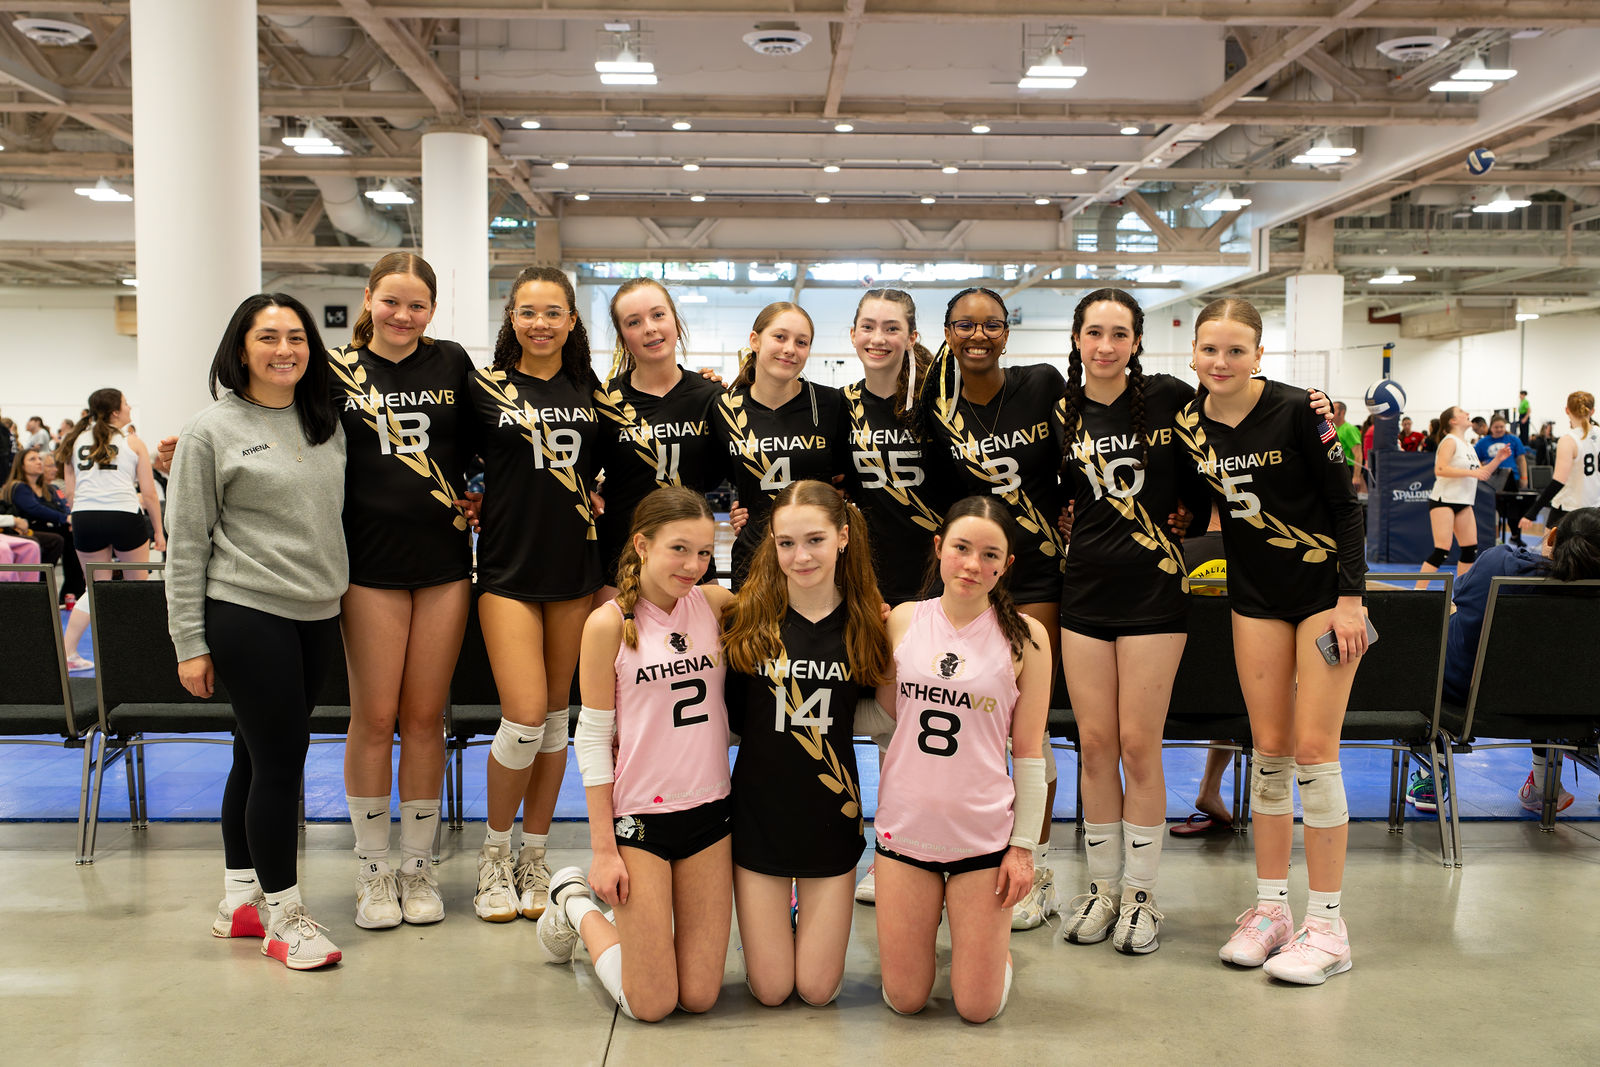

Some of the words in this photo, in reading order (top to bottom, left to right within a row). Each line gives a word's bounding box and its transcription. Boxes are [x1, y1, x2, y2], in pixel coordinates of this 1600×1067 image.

[344, 389, 455, 412] ATHENAVB
[498, 407, 599, 428] ATHENAV
[376, 412, 430, 455] 13
[531, 428, 582, 469] 19
[729, 435, 826, 456] ATHENAVB
[950, 421, 1050, 460] ATHENAVB
[655, 443, 680, 480] 11
[760, 456, 796, 490] 4
[852, 450, 925, 489] 55
[981, 456, 1022, 494] 3
[1085, 457, 1145, 500] 10
[1197, 450, 1283, 474] ATHENAVB
[1583, 453, 1600, 476] 8
[1221, 474, 1261, 518] 5
[671, 678, 709, 728] 2
[775, 686, 834, 734] 14
[900, 682, 998, 714] ATHENAVB
[918, 709, 962, 757] 8
